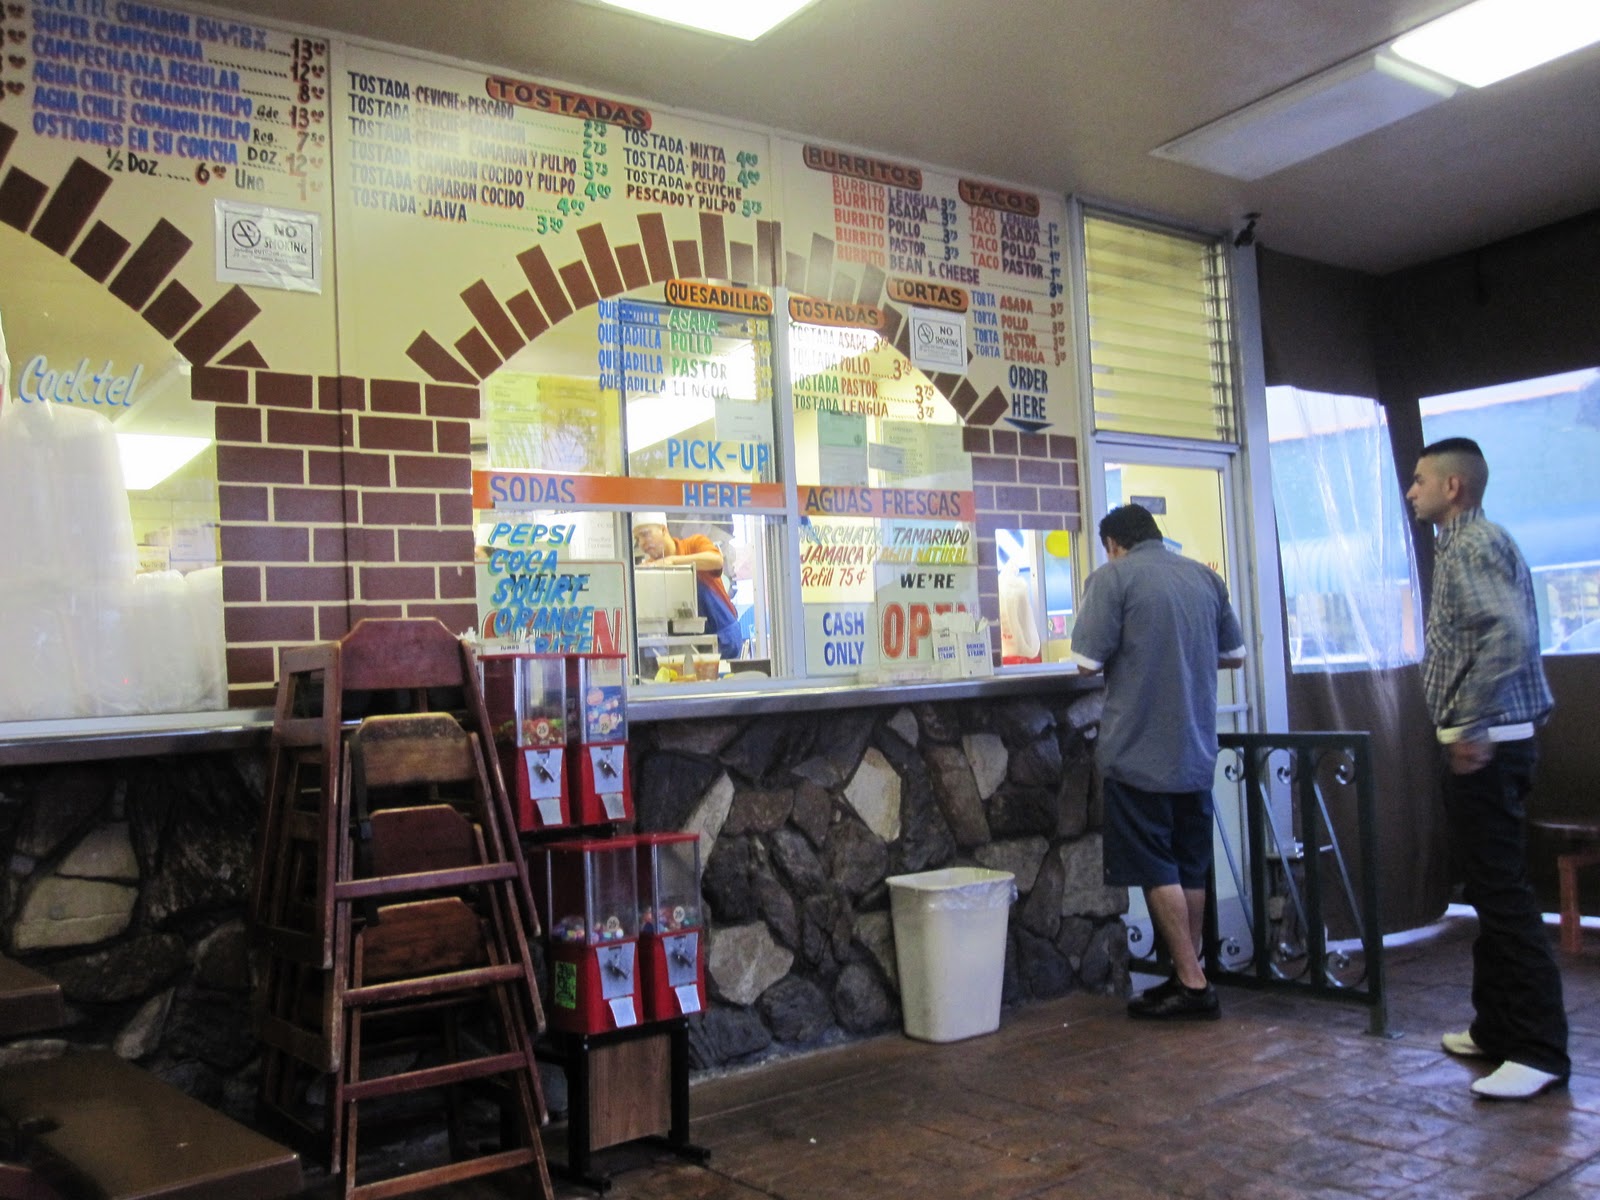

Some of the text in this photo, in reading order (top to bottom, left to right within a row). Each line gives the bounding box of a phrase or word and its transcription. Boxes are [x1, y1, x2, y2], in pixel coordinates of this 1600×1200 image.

[32, 9, 90, 39] SUPER
[95, 21, 204, 62] CAMPECHANA
[32, 34, 166, 80] CAMPECHANA
[168, 59, 240, 93] REGULAR
[32, 60, 78, 88] AGUA
[79, 68, 125, 97] CHILE
[131, 78, 203, 109] CAMARON
[211, 91, 252, 118] PULPO
[347, 71, 514, 121] TOSTADA CEVICHE PESCADO
[493, 77, 647, 129] TOSTADAS
[33, 85, 79, 115] AGUA
[82, 94, 126, 123] CHILE
[131, 102, 200, 136] CAMARON
[211, 117, 251, 143] PULPO
[348, 93, 410, 123] TOSTADA
[32, 111, 124, 148] OSTIONES
[128, 126, 148, 152] EN
[153, 130, 173, 155] SU
[176, 134, 238, 165] CONCHA
[348, 115, 412, 145] TOSTADA
[530, 151, 539, 168] Y
[541, 154, 577, 177] PULPO
[622, 126, 685, 156] TOSTADA
[690, 141, 727, 164] MIXTA
[348, 138, 411, 166] TOSTADA
[481, 163, 523, 187] COCIDO
[526, 170, 534, 189] Y
[538, 173, 576, 196] PULPO
[622, 147, 685, 176] TOSTADA
[692, 160, 727, 183] PULPO
[808, 147, 920, 187] BURRITOS
[349, 162, 413, 191] TOSTADA
[416, 174, 477, 202] CAMARON
[481, 184, 525, 209] COCIDO
[623, 167, 743, 201] TOSTADA CEVICHE
[626, 184, 737, 214] PESCADO Y PULPO
[832, 174, 939, 211] BURRITO LENGUA
[964, 180, 1038, 213] TACOS
[350, 185, 417, 214] TOSTADA
[423, 198, 467, 223] JAIVA
[833, 188, 885, 214] BURRITO
[888, 200, 928, 224] ASADA
[273, 223, 297, 238] NO
[834, 207, 885, 231] BURRITO
[888, 217, 921, 239] POLLO
[969, 216, 1041, 247] TACO ASADA
[264, 236, 307, 254] SMOKING
[835, 226, 885, 249] BURRITO
[889, 236, 927, 258] PASTOR
[969, 233, 1037, 260] TACO POLLO
[837, 244, 886, 268] BURRITO
[889, 254, 923, 275] BEAN
[939, 261, 980, 286] CHEESE
[970, 251, 1044, 279] TACO PASTOR
[668, 282, 769, 312] QUESADILLAS
[892, 278, 963, 308] TORTAS
[971, 289, 1034, 315] TORTA ASADA
[667, 308, 719, 336] ASADA
[793, 299, 880, 326] TOSTADAS
[972, 309, 1029, 332] TORTA POLLO
[597, 322, 713, 356] QUESADILLA POLLO
[838, 331, 869, 354] ASADA
[939, 325, 953, 337] NO
[973, 327, 1038, 350] TORTA PASTOR
[597, 348, 728, 381] QUESADILLA PASTOR
[840, 356, 871, 375] POLLO
[974, 343, 1001, 359] TORTA
[1003, 347, 1046, 366] LENGUA
[599, 372, 667, 394] QUESADILLA
[793, 372, 840, 394] TOSTADA
[841, 377, 879, 399] PASTOR
[1008, 364, 1048, 394] ORDER
[793, 393, 840, 412] TOSTADA
[842, 399, 890, 418] LENGUA
[1012, 392, 1047, 421] HERE
[667, 438, 770, 473] PICK-UP
[489, 475, 577, 503] SODAS
[682, 482, 752, 508] HERE
[804, 487, 961, 517] AGUAS FRESCAS
[487, 522, 577, 547] PEPSI
[893, 527, 971, 546] TAMARINDO
[488, 549, 558, 577] COCA
[799, 545, 864, 566] JAMAICA
[915, 545, 969, 565] NATURAL
[490, 575, 589, 608] SQUIRT
[801, 566, 834, 588] Refill
[900, 573, 956, 589] WE'RE
[493, 606, 595, 638] ORANGE
[822, 612, 865, 637] CASH
[823, 641, 865, 667] ONLY
